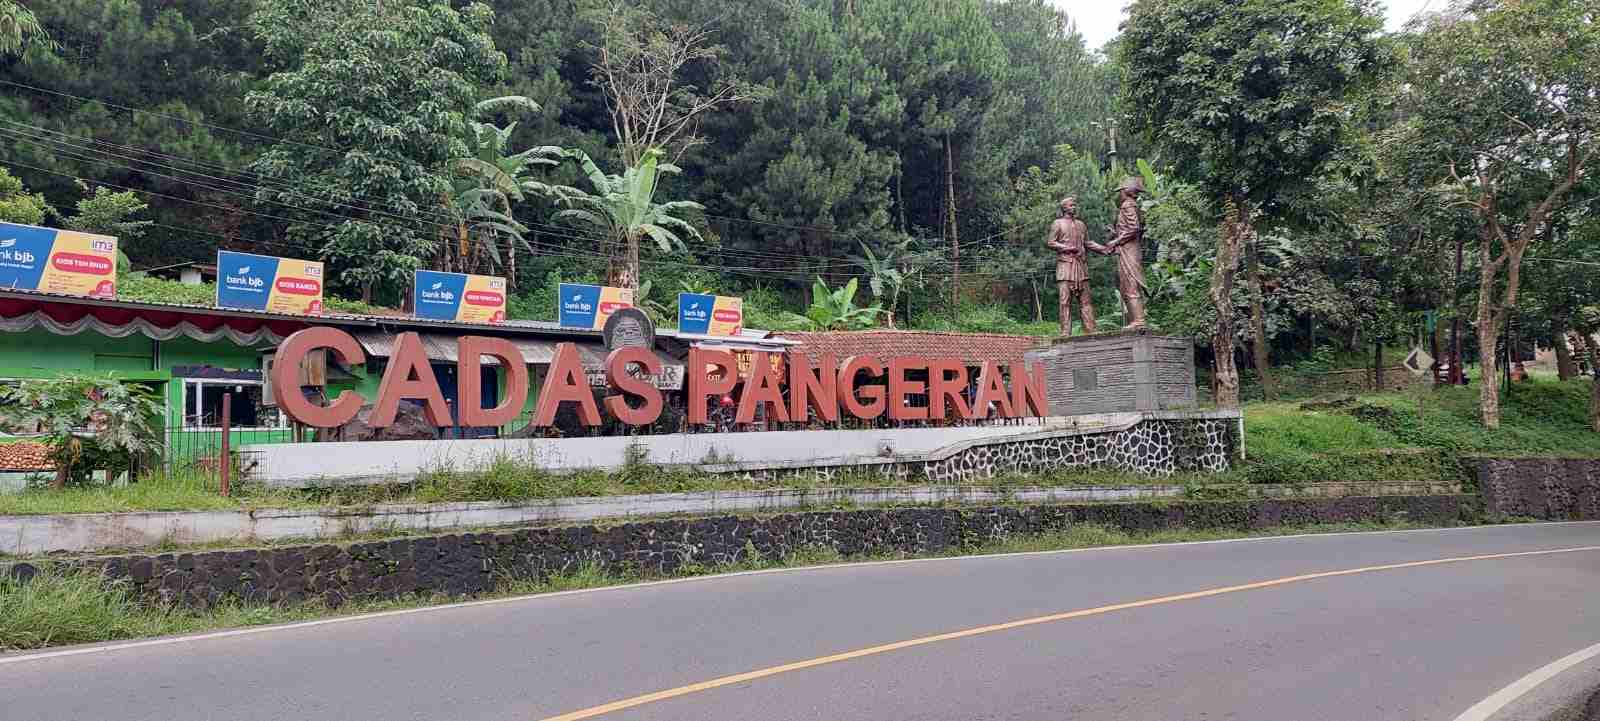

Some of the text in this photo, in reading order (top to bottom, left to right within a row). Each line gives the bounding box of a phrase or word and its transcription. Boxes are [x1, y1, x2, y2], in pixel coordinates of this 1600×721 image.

[14, 250, 34, 264] bjb
[226, 275, 264, 288] bank bjb
[422, 290, 454, 301] bank bjb
[564, 302, 580, 310] bank
[271, 326, 1048, 429] CADAS PANGERAN
